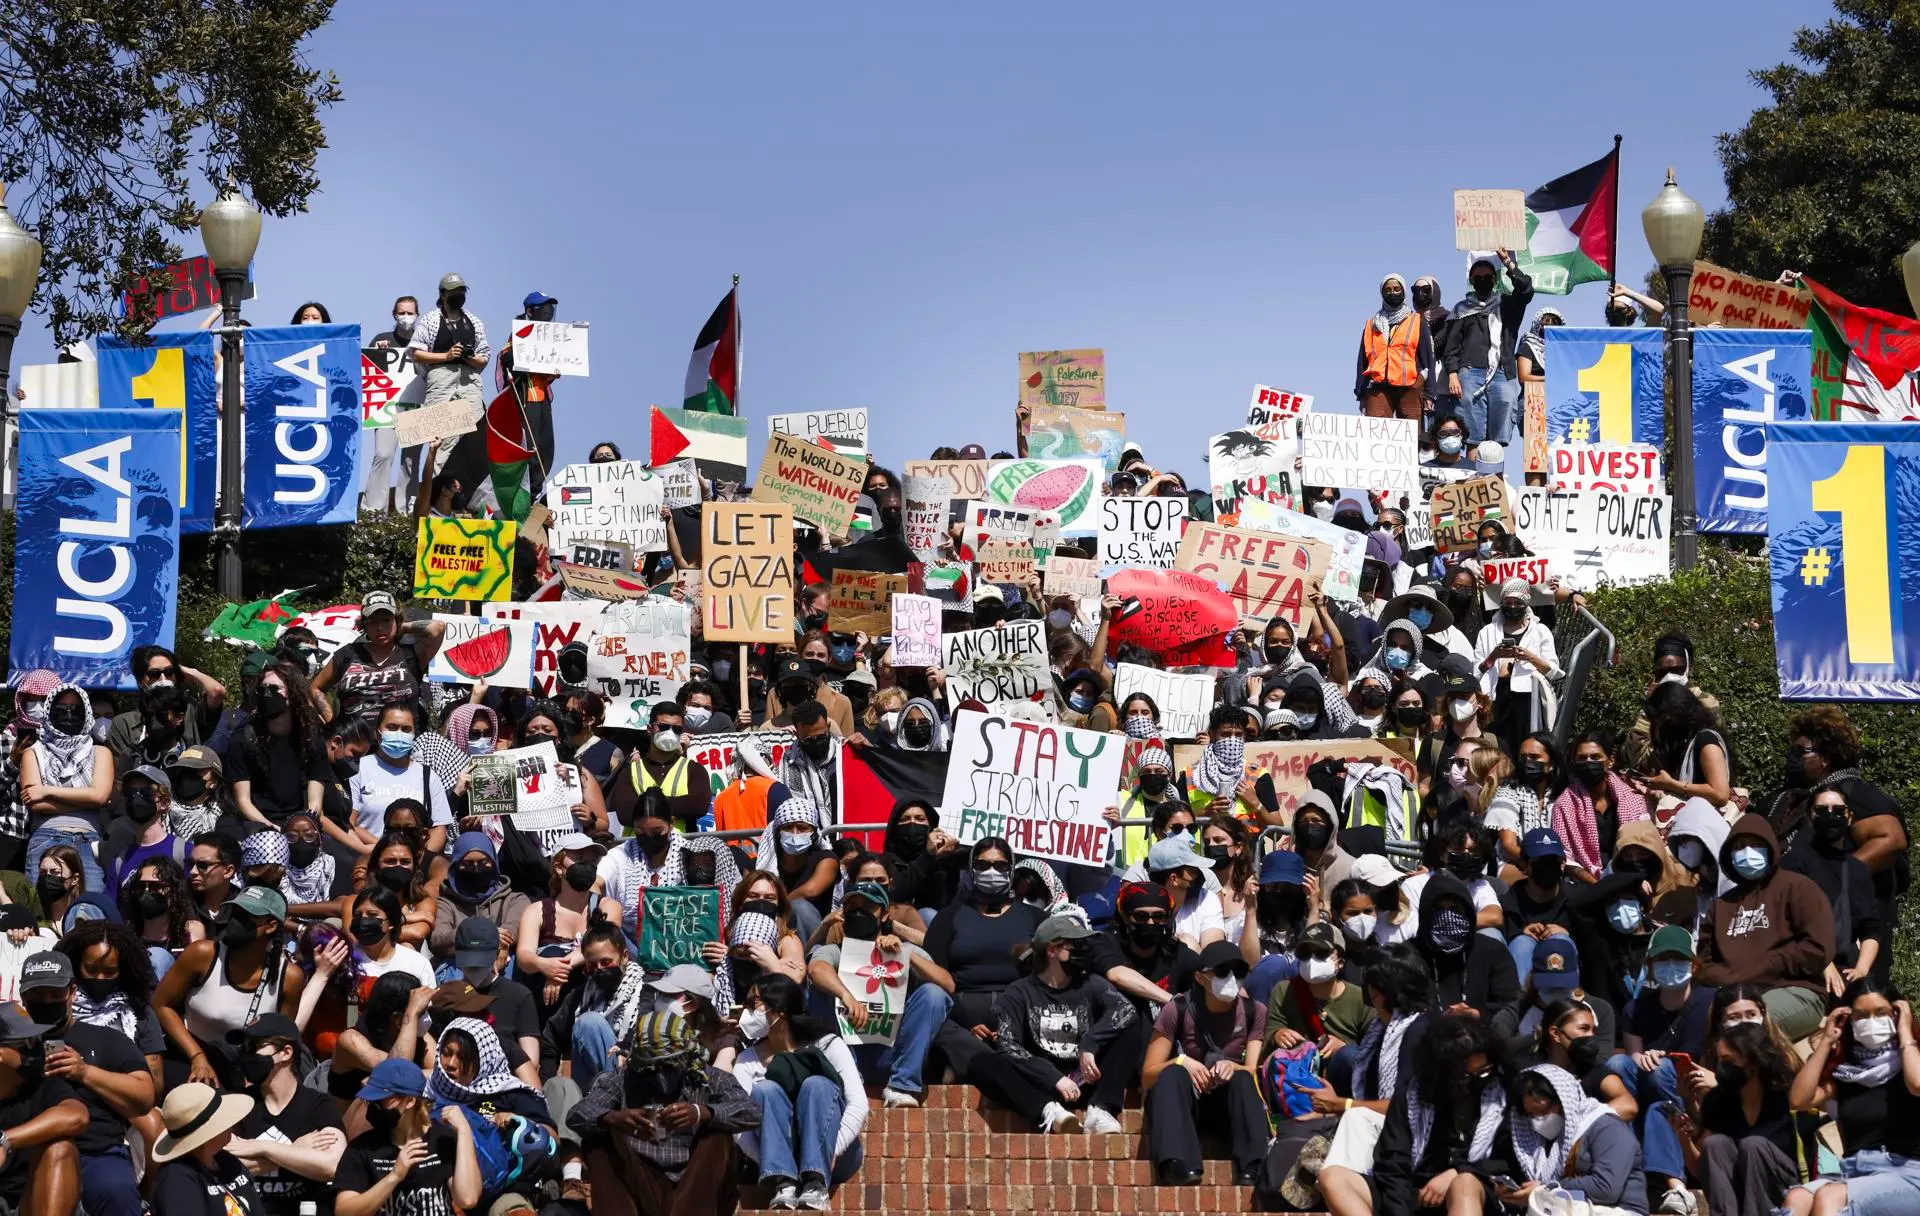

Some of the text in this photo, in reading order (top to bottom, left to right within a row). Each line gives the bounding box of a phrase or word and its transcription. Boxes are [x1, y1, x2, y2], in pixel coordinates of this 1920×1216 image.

[1691, 272, 1724, 295] NO
[1727, 281, 1775, 305] MORE
[1689, 294, 1718, 316] ON
[536, 323, 573, 343] FREE
[1057, 367, 1099, 382] Palestine
[1258, 389, 1303, 413] FREE
[1569, 344, 1633, 444] #1
[273, 343, 332, 505] UCLA
[773, 412, 866, 436] EL PUEBLO
[1344, 416, 1364, 438] LA
[1722, 349, 1775, 510] UCLA
[774, 437, 797, 458] The
[800, 449, 845, 477] WORLD
[847, 467, 863, 484] IS
[1303, 438, 1413, 466] ESTAN CON
[553, 464, 654, 487] LATINAS
[1556, 449, 1657, 479] DIVEST
[669, 474, 691, 486] FREE
[778, 460, 860, 504] WATCHING
[990, 461, 1048, 505] FREE
[1304, 466, 1336, 487] LOS
[1345, 468, 1367, 487] DE
[1369, 469, 1413, 491] GAZA
[615, 486, 626, 503] 4
[664, 486, 693, 498] STINE
[763, 475, 845, 515] Claremont in
[1441, 481, 1502, 512] SIKHS
[929, 502, 943, 510] THE
[1103, 498, 1184, 532] STOP
[1456, 509, 1477, 521] for
[1519, 492, 1663, 540] STATE POWER
[710, 511, 782, 545] LET
[906, 525, 915, 533] TO
[907, 512, 940, 524] RIVER
[53, 435, 137, 656] UCLA
[908, 534, 932, 548] SEA
[1132, 532, 1157, 542] THE
[1198, 529, 1286, 568] FREE
[434, 544, 484, 558] FREE FREE
[1008, 549, 1032, 559] FREE
[1107, 541, 1144, 560] U.S.
[1801, 445, 1893, 664] #1
[431, 557, 484, 573] PALESTINE
[567, 568, 606, 581] FREE
[707, 555, 792, 589] GAZA
[981, 561, 1033, 573] PALESTINE
[1050, 559, 1097, 577] LOVE
[1484, 558, 1549, 586] DIVEST
[836, 573, 898, 591] NO ONE IS
[709, 594, 785, 632] LIVE
[831, 599, 888, 613] UNTIL WE
[895, 597, 932, 622] Long
[1145, 596, 1197, 611] DIVEST
[601, 605, 688, 638] FROM
[895, 612, 938, 636] Live
[1145, 611, 1198, 624] DISCLOSE
[445, 622, 511, 641] DIVEST
[1169, 623, 1219, 637] POLICING
[949, 623, 1043, 666] ANOTHER
[622, 650, 689, 682] RIVER
[597, 677, 662, 698] TO THE
[951, 675, 1039, 705] WORLD
[1116, 664, 1208, 714] PROTECT
[995, 703, 1007, 715] IS
[472, 757, 512, 766] FREE FREE
[972, 716, 1107, 789] STAY
[962, 769, 1080, 822] STRONG
[473, 803, 515, 813] PALESTINE
[648, 893, 709, 918] CEASE
[662, 916, 702, 937] FIRE
[650, 938, 704, 960] NOW
